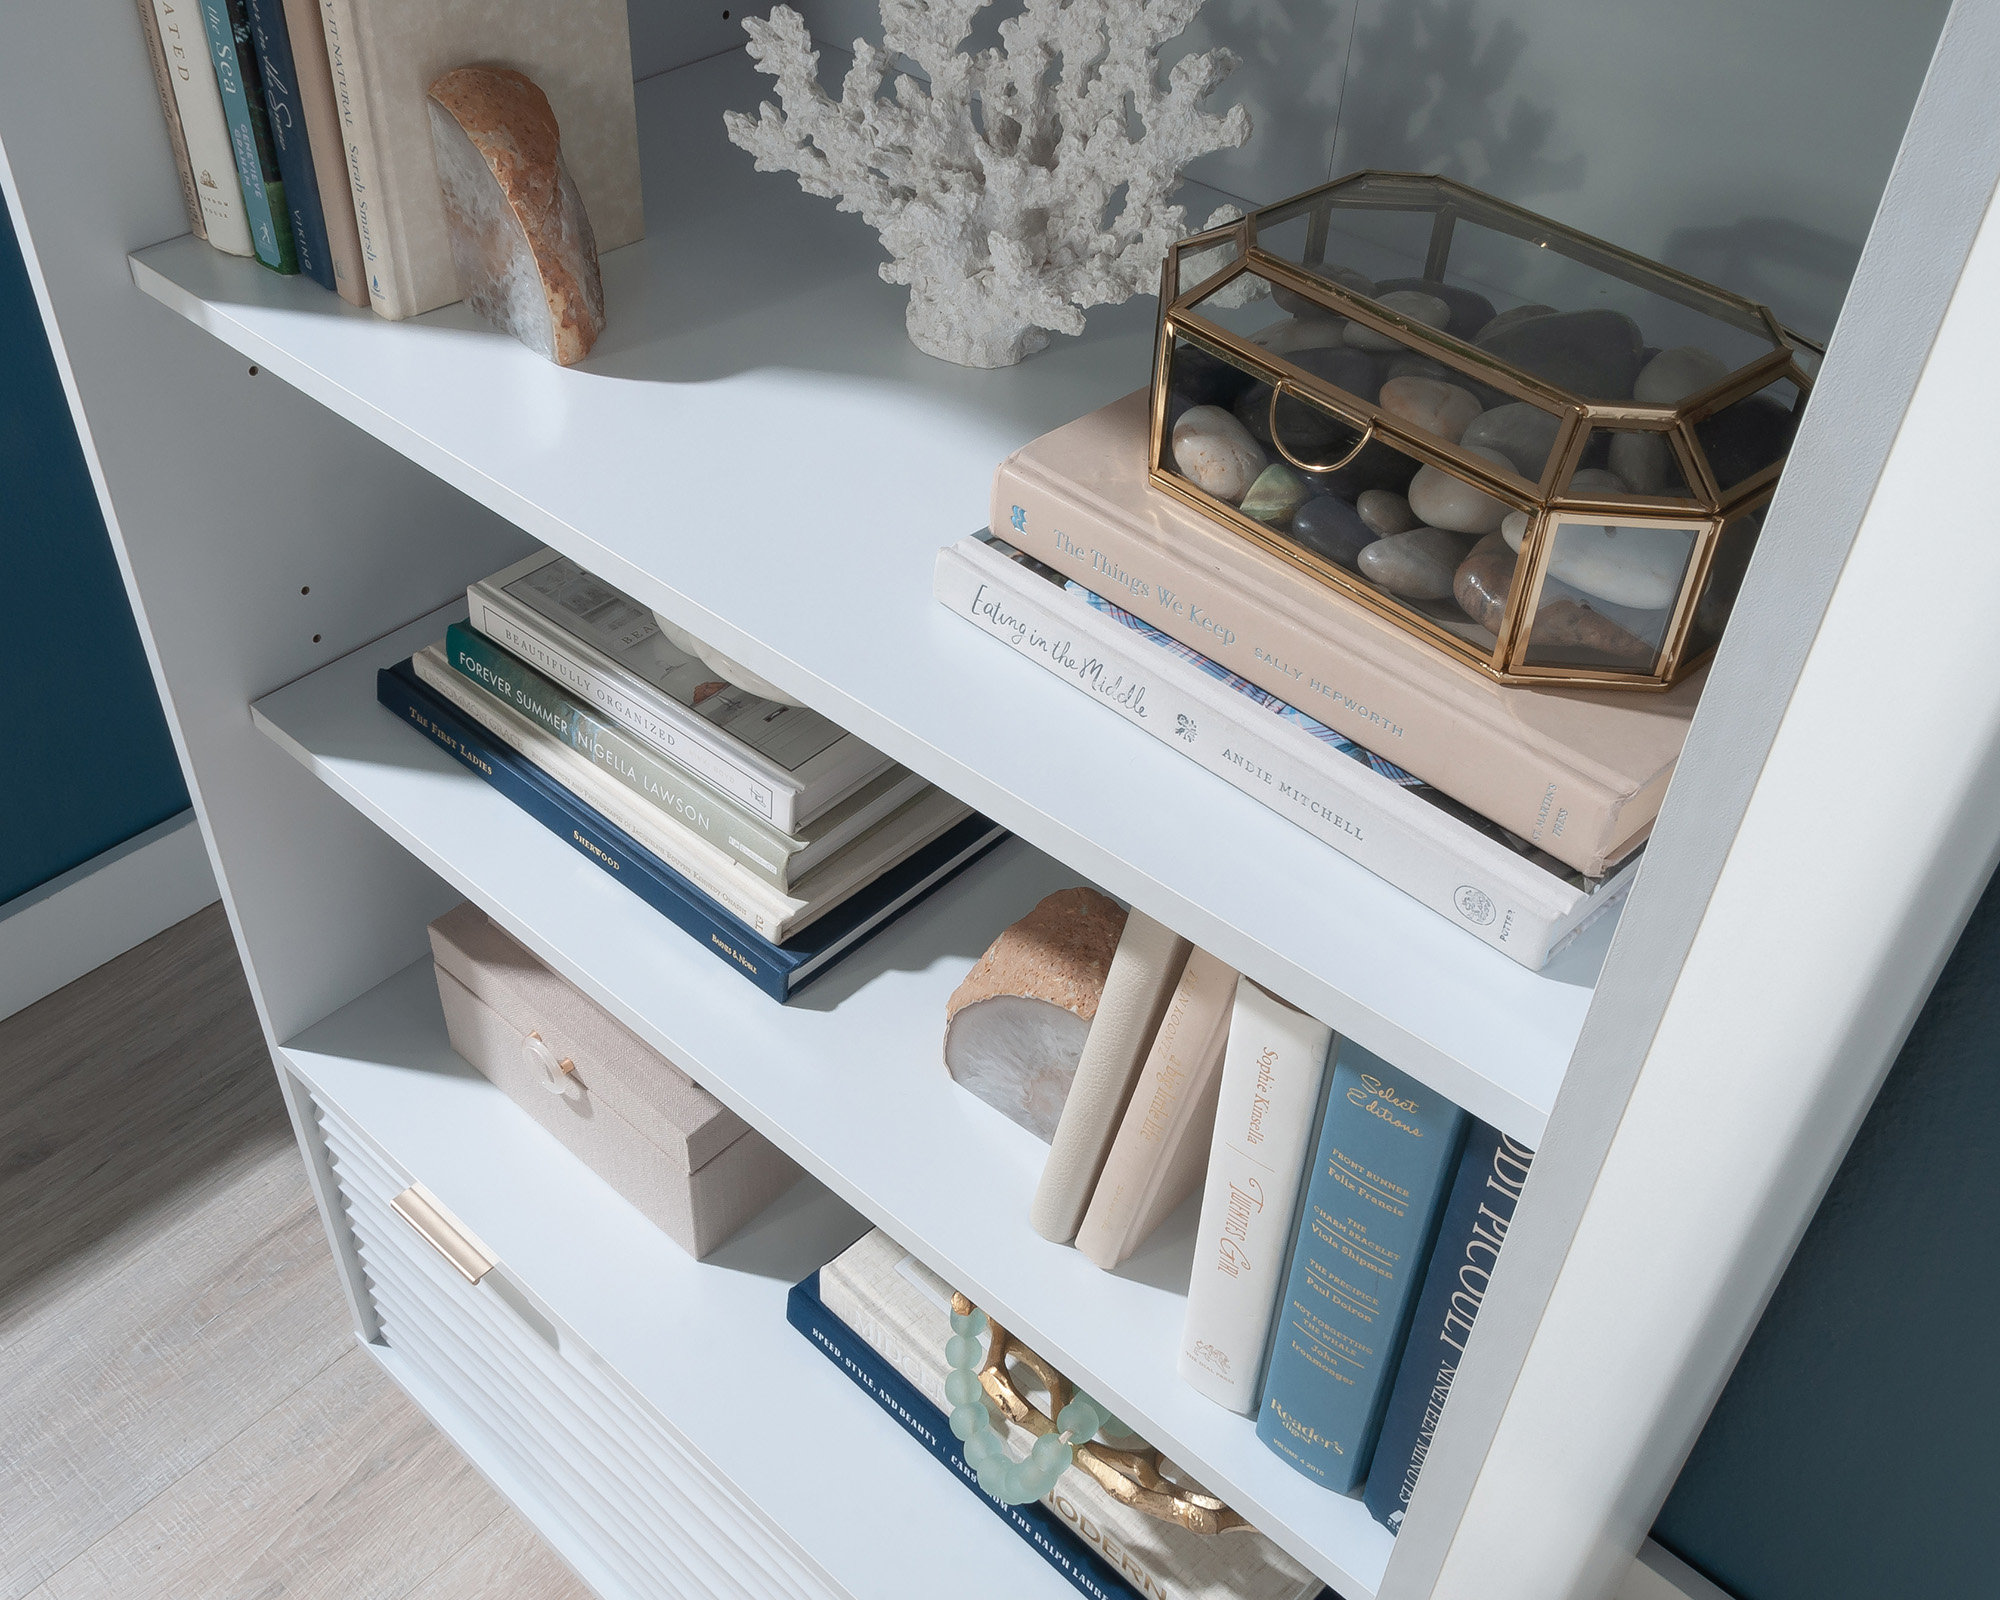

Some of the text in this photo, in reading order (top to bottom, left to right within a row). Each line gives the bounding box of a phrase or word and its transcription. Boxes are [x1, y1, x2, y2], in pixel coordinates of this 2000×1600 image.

[328, 19, 339, 40] IT
[215, 41, 237, 94] Sea
[333, 43, 353, 128] NATURAL
[268, 89, 292, 151] Snow
[234, 128, 250, 186] GRAHAM
[240, 123, 262, 200] GENEVIEVE
[349, 142, 377, 262] Sarah Smarsh
[293, 209, 313, 271] VIKING
[1053, 529, 1236, 647] The Things We Keep
[971, 584, 1148, 718] Eating in the Middle
[505, 629, 676, 746] BEAUTIFULLY ORGANIZED
[1254, 647, 1404, 738] SALLY HEPWORTH
[459, 651, 512, 698] FOREVER
[516, 690, 569, 736] SUMMER
[577, 731, 638, 782] NIGELLA
[643, 775, 710, 831] LAWSON
[1222, 748, 1364, 842] ANDIE MITCHELL
[1536, 782, 1557, 829] MARTIN'S
[1552, 807, 1568, 838] PRESS
[732, 949, 740, 961] &
[1158, 1003, 1184, 1059] KOONTZ
[1148, 1087, 1179, 1120] little
[1246, 1046, 1279, 1145] Sophie Kinsella
[1346, 1087, 1424, 1138] Editions
[1360, 1073, 1419, 1114] Select
[1140, 1118, 1167, 1143] life
[1328, 1166, 1405, 1218] Felix Francis
[1332, 1147, 1410, 1198] FRONT RUNNER
[1311, 1221, 1394, 1280] Viola Shipman
[1313, 1204, 1401, 1261] CHARM BRACELET
[1346, 1216, 1367, 1234] THE
[1306, 1275, 1373, 1323] Paul Doiron
[1310, 1257, 1380, 1306] THE PRECIPICE
[1293, 1299, 1374, 1355] NOT FORGETTING
[1303, 1317, 1358, 1357] THE WHALE
[1291, 1339, 1356, 1386] Ironmonger
[1311, 1344, 1338, 1367] John
[812, 1327, 938, 1447] SPEED, STYLE, AND BEAUTY
[1270, 1397, 1345, 1456] Reader's
[1273, 1438, 1299, 1460] VOLUME
[1281, 1420, 1312, 1445] digest
[1399, 1359, 1457, 1504] NINETEEN MINUTES
[950, 1454, 978, 1484] CARS
[1011, 1509, 1032, 1534] THE
[1034, 1531, 1070, 1570] RALPH
